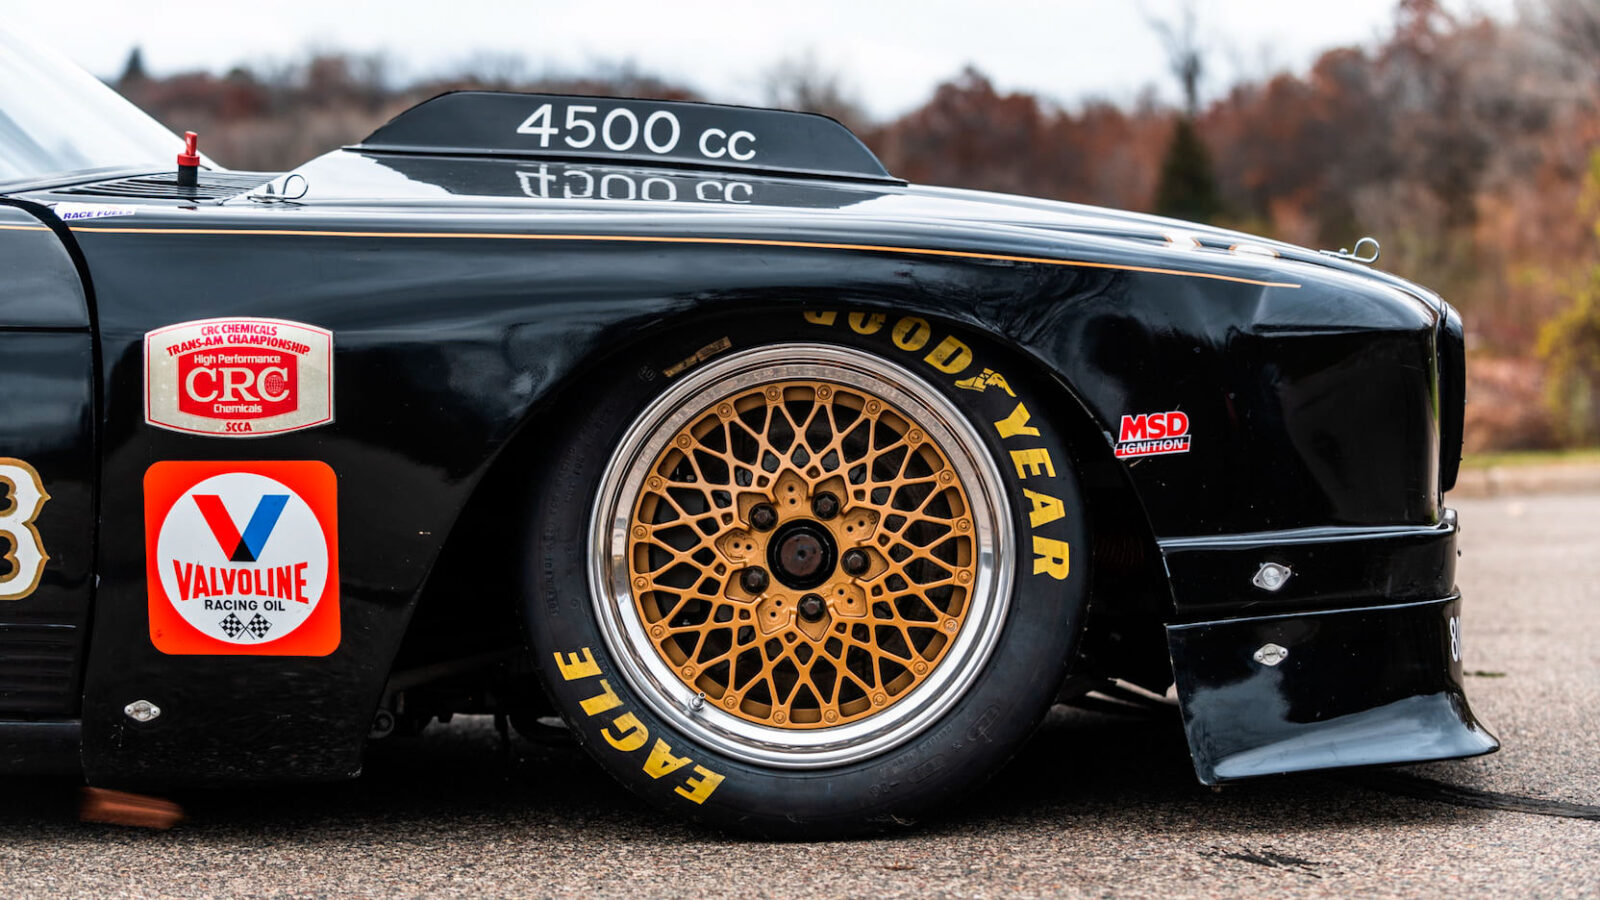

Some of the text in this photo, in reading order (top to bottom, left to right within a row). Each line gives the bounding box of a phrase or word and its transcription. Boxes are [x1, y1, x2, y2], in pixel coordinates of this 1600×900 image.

[516, 103, 757, 161] 4500 cc
[63, 210, 94, 220] RACE
[201, 324, 278, 337] CRC CHEMICALS
[166, 334, 311, 357] TRANS-AM CHAMPIONSHIP
[193, 354, 281, 365] High Performance
[185, 366, 290, 402] CRC
[213, 403, 263, 413] Chemicals
[225, 421, 253, 432] SCCA
[1120, 411, 1188, 441] MSD
[1121, 438, 1184, 454] IGNITION
[172, 559, 310, 605] VALVOLINE
[204, 599, 286, 612] RACING OIL
[553, 646, 726, 805] EAGLE
